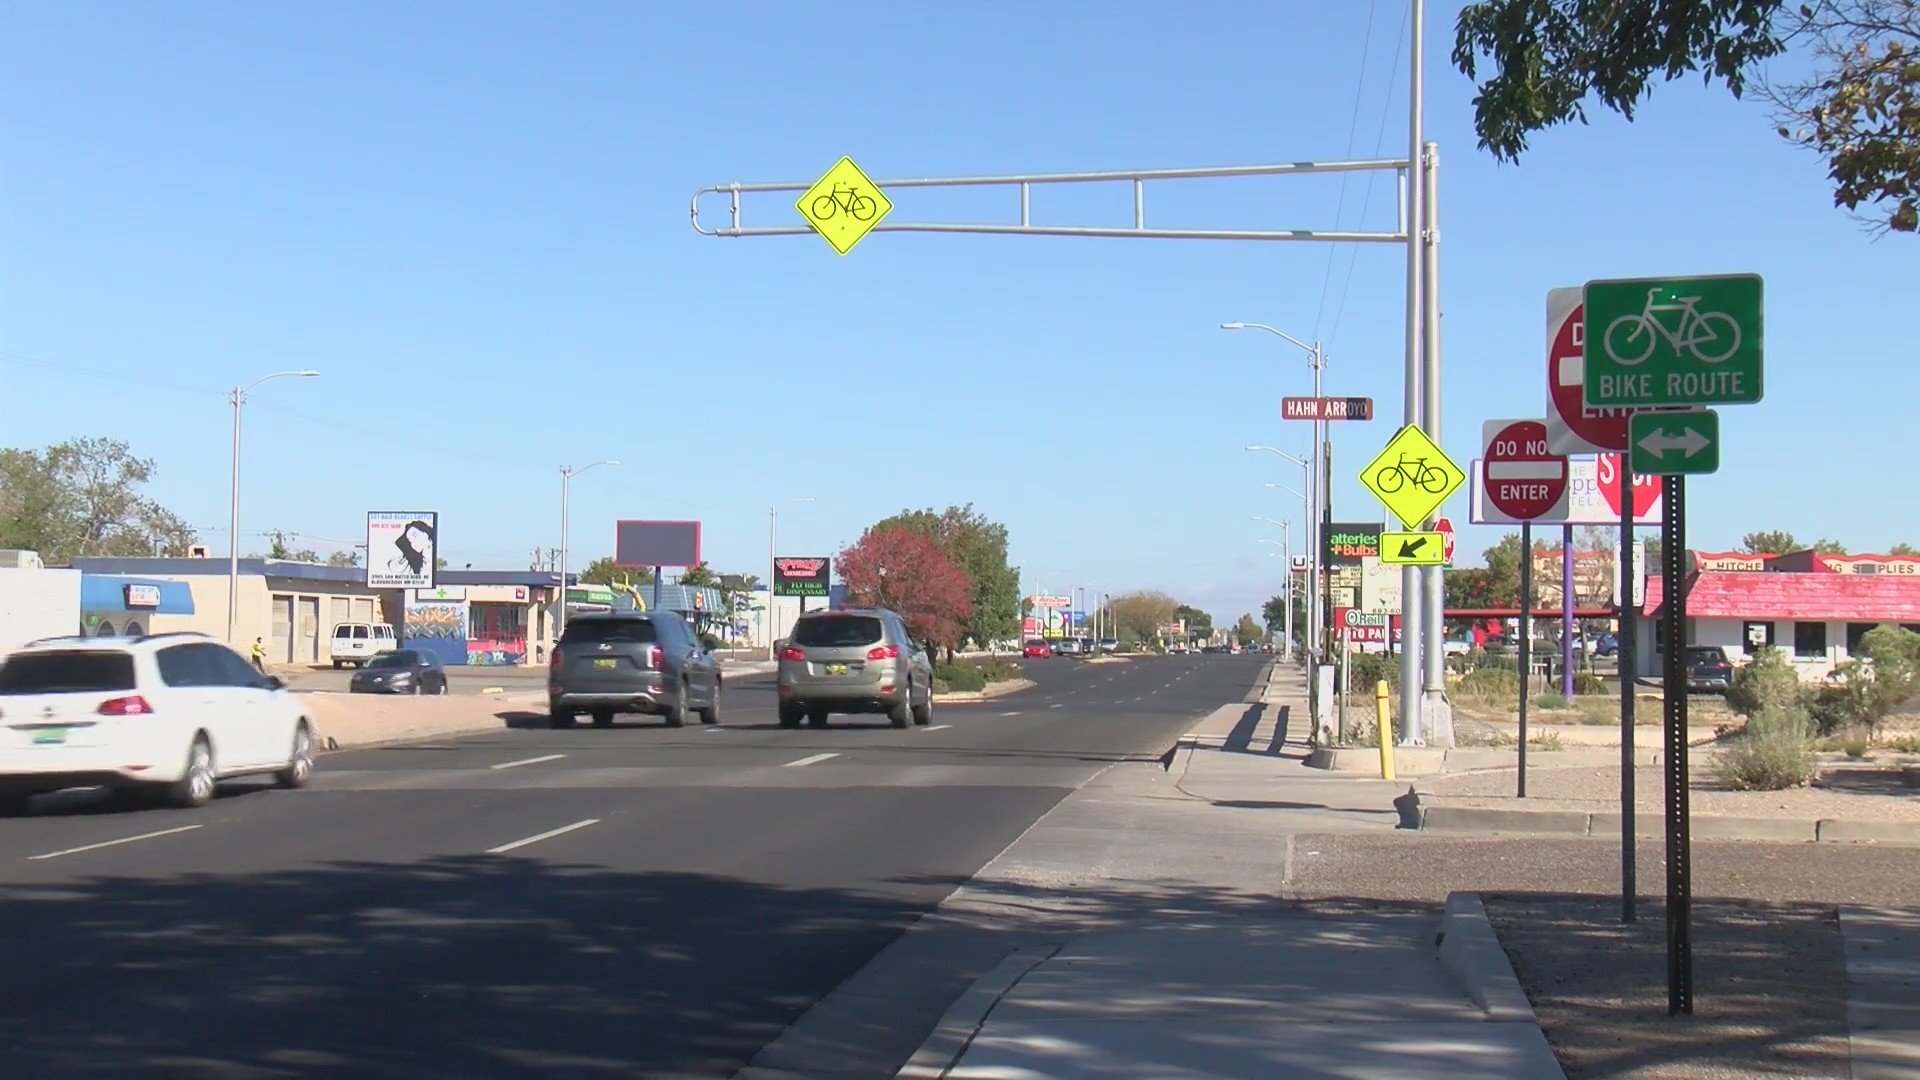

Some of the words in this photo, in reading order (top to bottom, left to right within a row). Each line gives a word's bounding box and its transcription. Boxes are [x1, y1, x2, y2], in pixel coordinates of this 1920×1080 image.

[1600, 374, 1653, 399] BIKE
[1667, 371, 1745, 397] ROUTE
[1287, 401, 1318, 416] HAHN
[1324, 401, 1367, 416] ARROYO
[1496, 440, 1517, 456] DO
[1526, 441, 1547, 456] NO
[1500, 485, 1548, 500] ENTER
[1331, 533, 1377, 544] atteries
[1717, 562, 1761, 570] HITCHE
[1852, 564, 1914, 574] SPLIES
[1346, 609, 1385, 626] O'Reill
